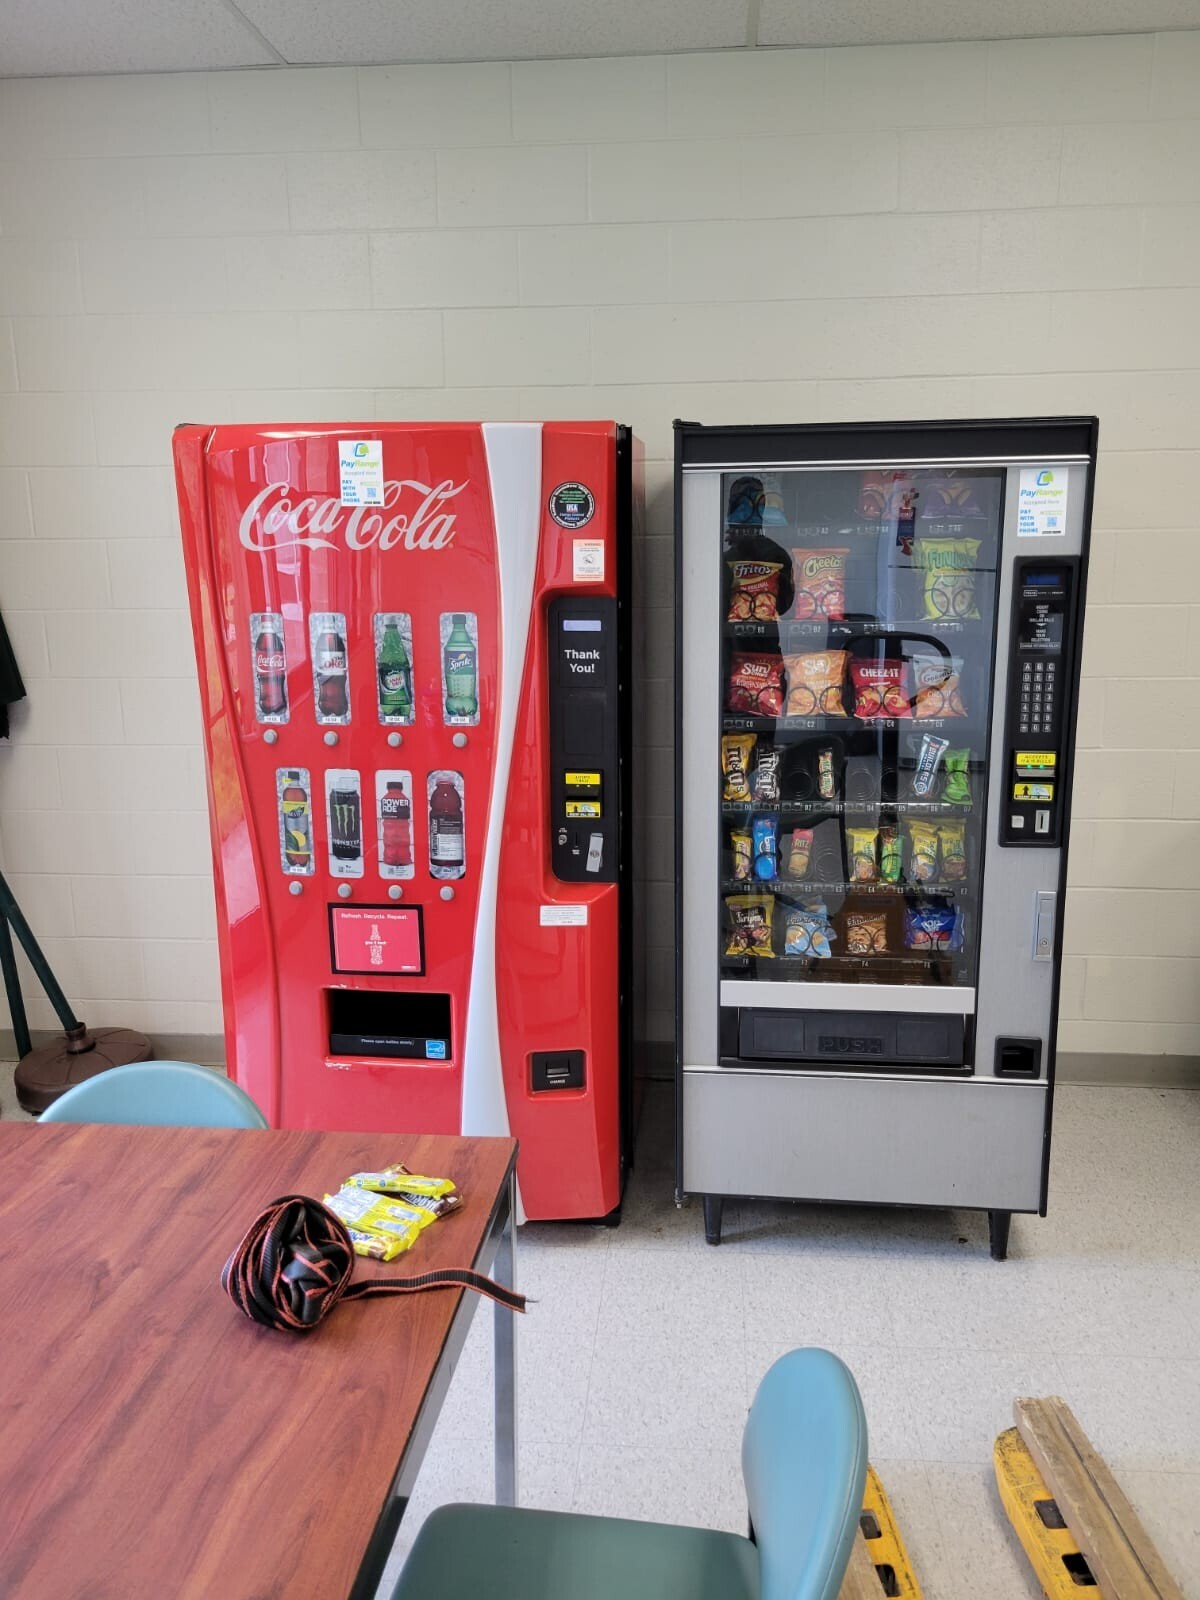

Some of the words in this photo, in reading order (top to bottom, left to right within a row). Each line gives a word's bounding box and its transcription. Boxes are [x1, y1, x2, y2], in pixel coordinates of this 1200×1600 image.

[341, 460, 380, 469] PayRange
[1020, 489, 1064, 498] PayRange
[564, 649, 601, 660] Thank
[450, 657, 472, 672] Sprite
[570, 663, 595, 673] You!
[859, 667, 899, 678] CHEEZ-IT
[382, 798, 409, 807] POWER
[794, 838, 809, 849] RITZ
[822, 1038, 882, 1053] PUSH
